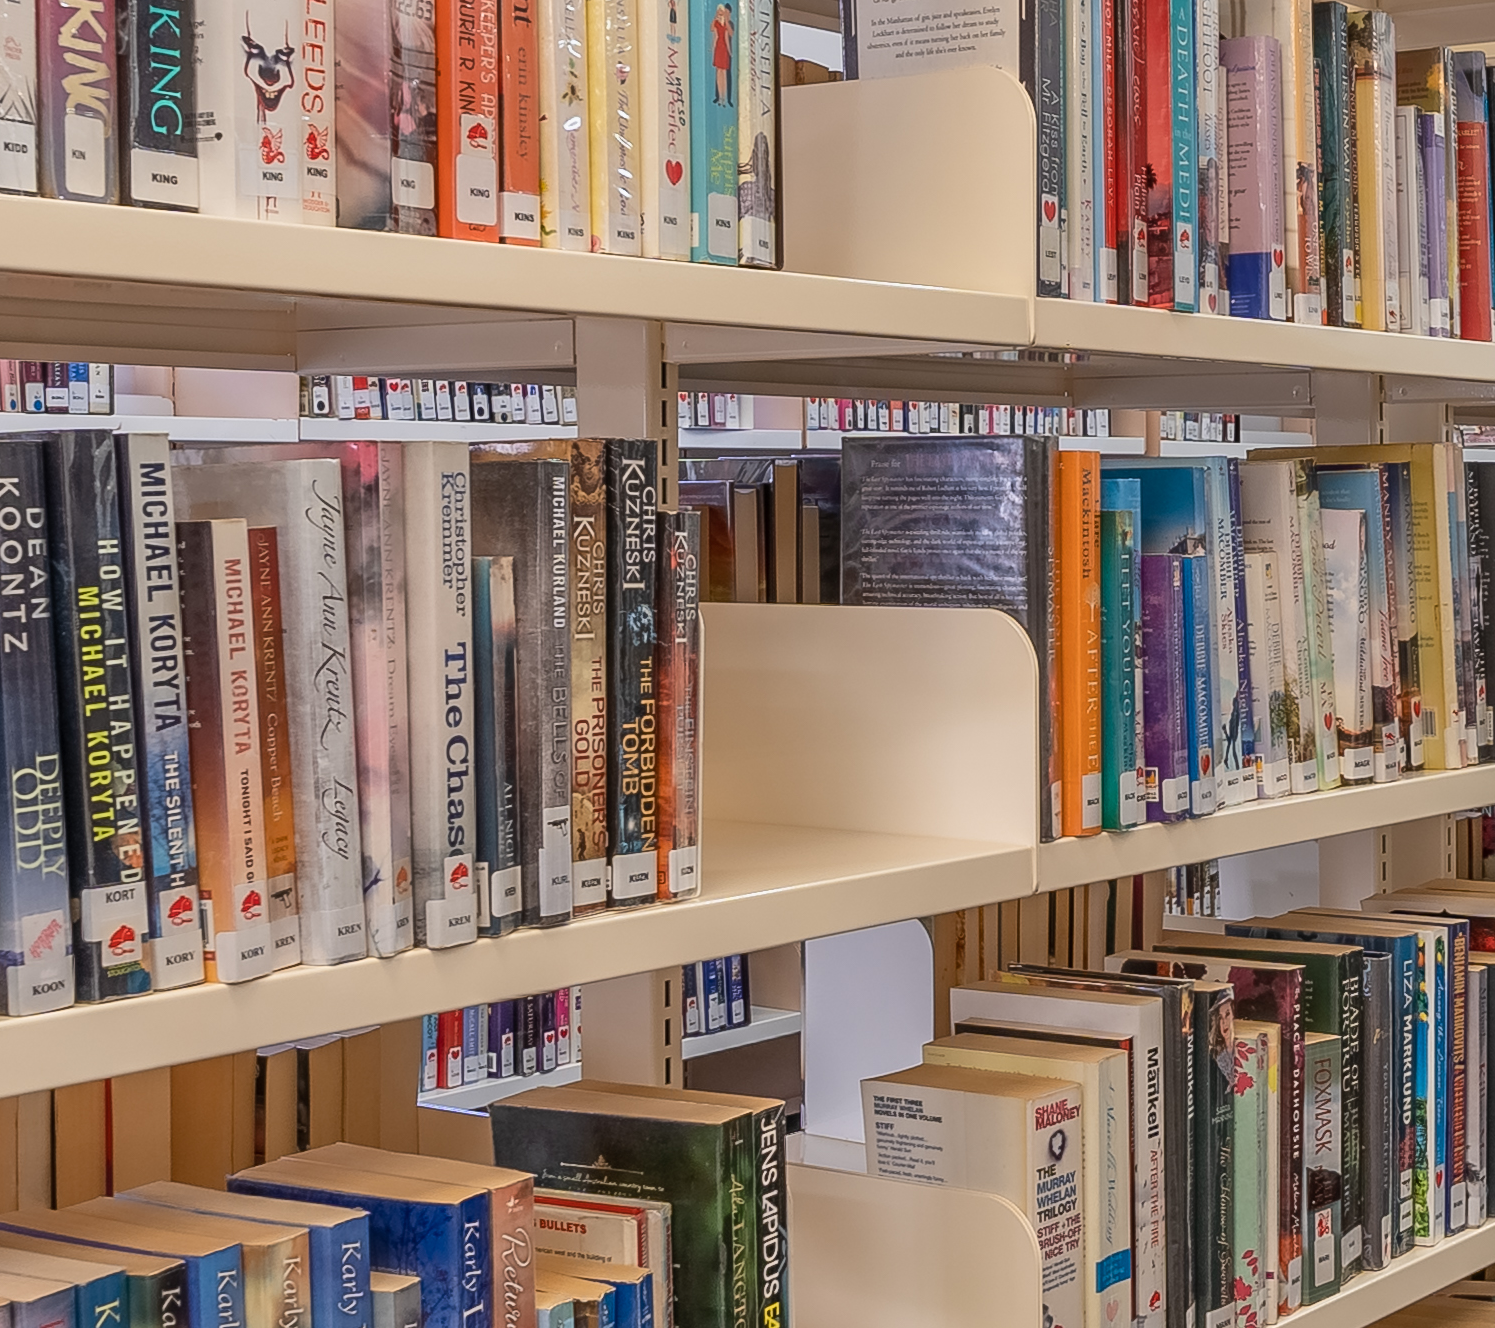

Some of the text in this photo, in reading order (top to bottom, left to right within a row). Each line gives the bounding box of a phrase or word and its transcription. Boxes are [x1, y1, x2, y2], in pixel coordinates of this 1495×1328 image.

[151, 173, 178, 187] KING
[621, 458, 647, 592] KUZNESKI
[642, 485, 658, 564] CHRIS
[139, 462, 182, 733] MICHAEL KORYTA
[620, 719, 639, 797] TOMB
[640, 688, 658, 853] FORBIDDEN
[106, 888, 136, 904] KORT
[1035, 1099, 1068, 1118] SHANE
[1035, 1105, 1081, 1131] MALONEY
[1314, 1057, 1333, 1155] FOXMASK
[759, 1116, 779, 1298] JENS LAPIDUS
[1037, 1171, 1076, 1195] MURRAY
[1037, 1185, 1076, 1208] WHELAN
[1037, 1199, 1076, 1223] TRILOGY
